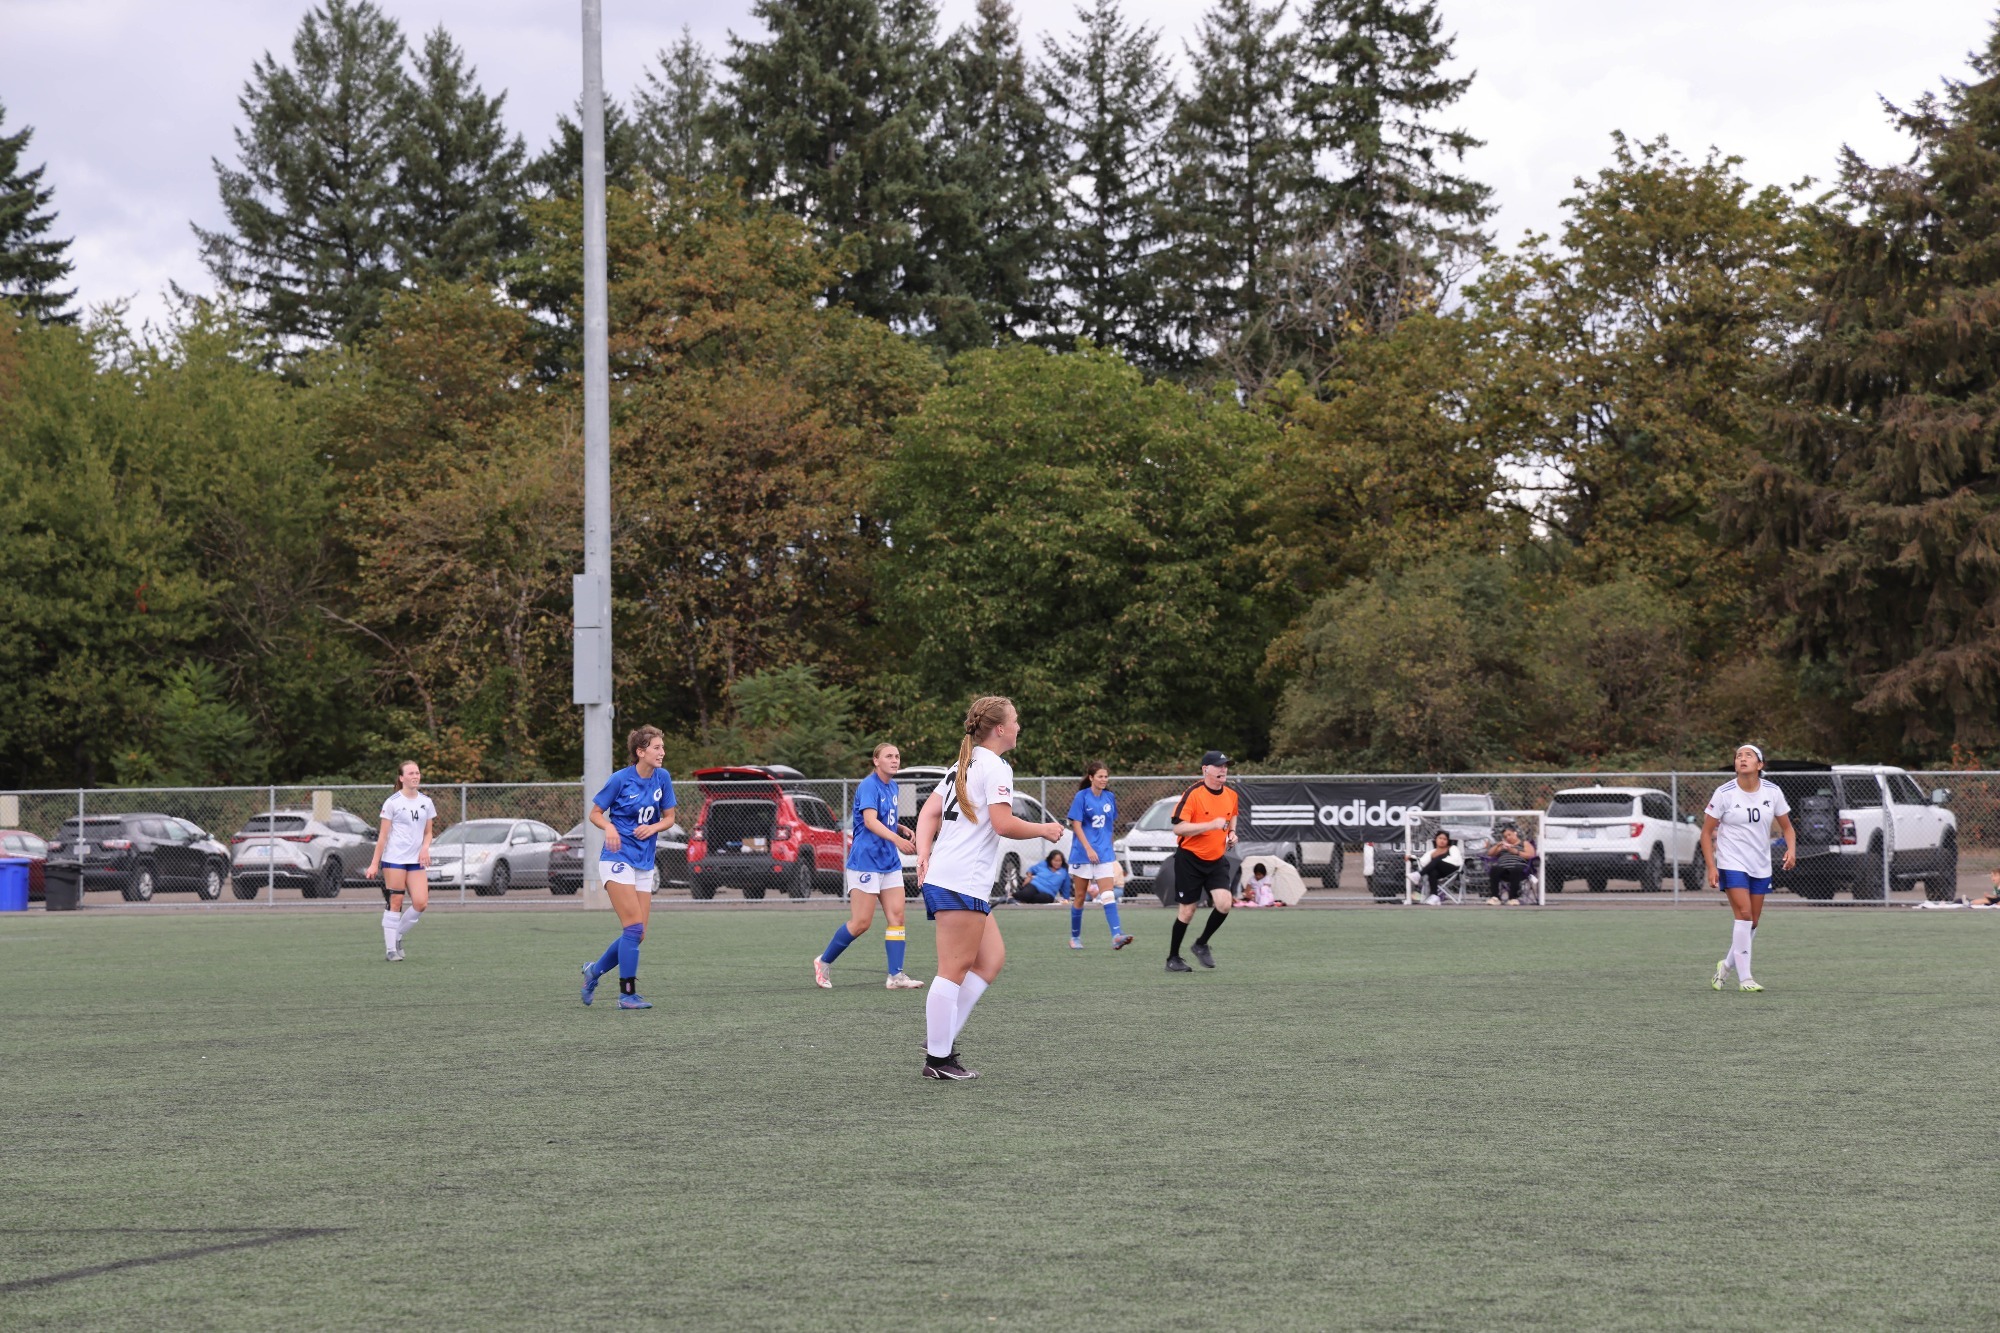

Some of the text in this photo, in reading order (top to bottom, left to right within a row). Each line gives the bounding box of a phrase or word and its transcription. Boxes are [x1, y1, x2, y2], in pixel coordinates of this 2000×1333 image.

[410, 809, 419, 821] 14
[638, 806, 655, 823] 10
[887, 808, 896, 826] 15
[1318, 799, 1422, 826] adidas
[1747, 808, 1760, 823] 10
[1092, 815, 1106, 828] 23
